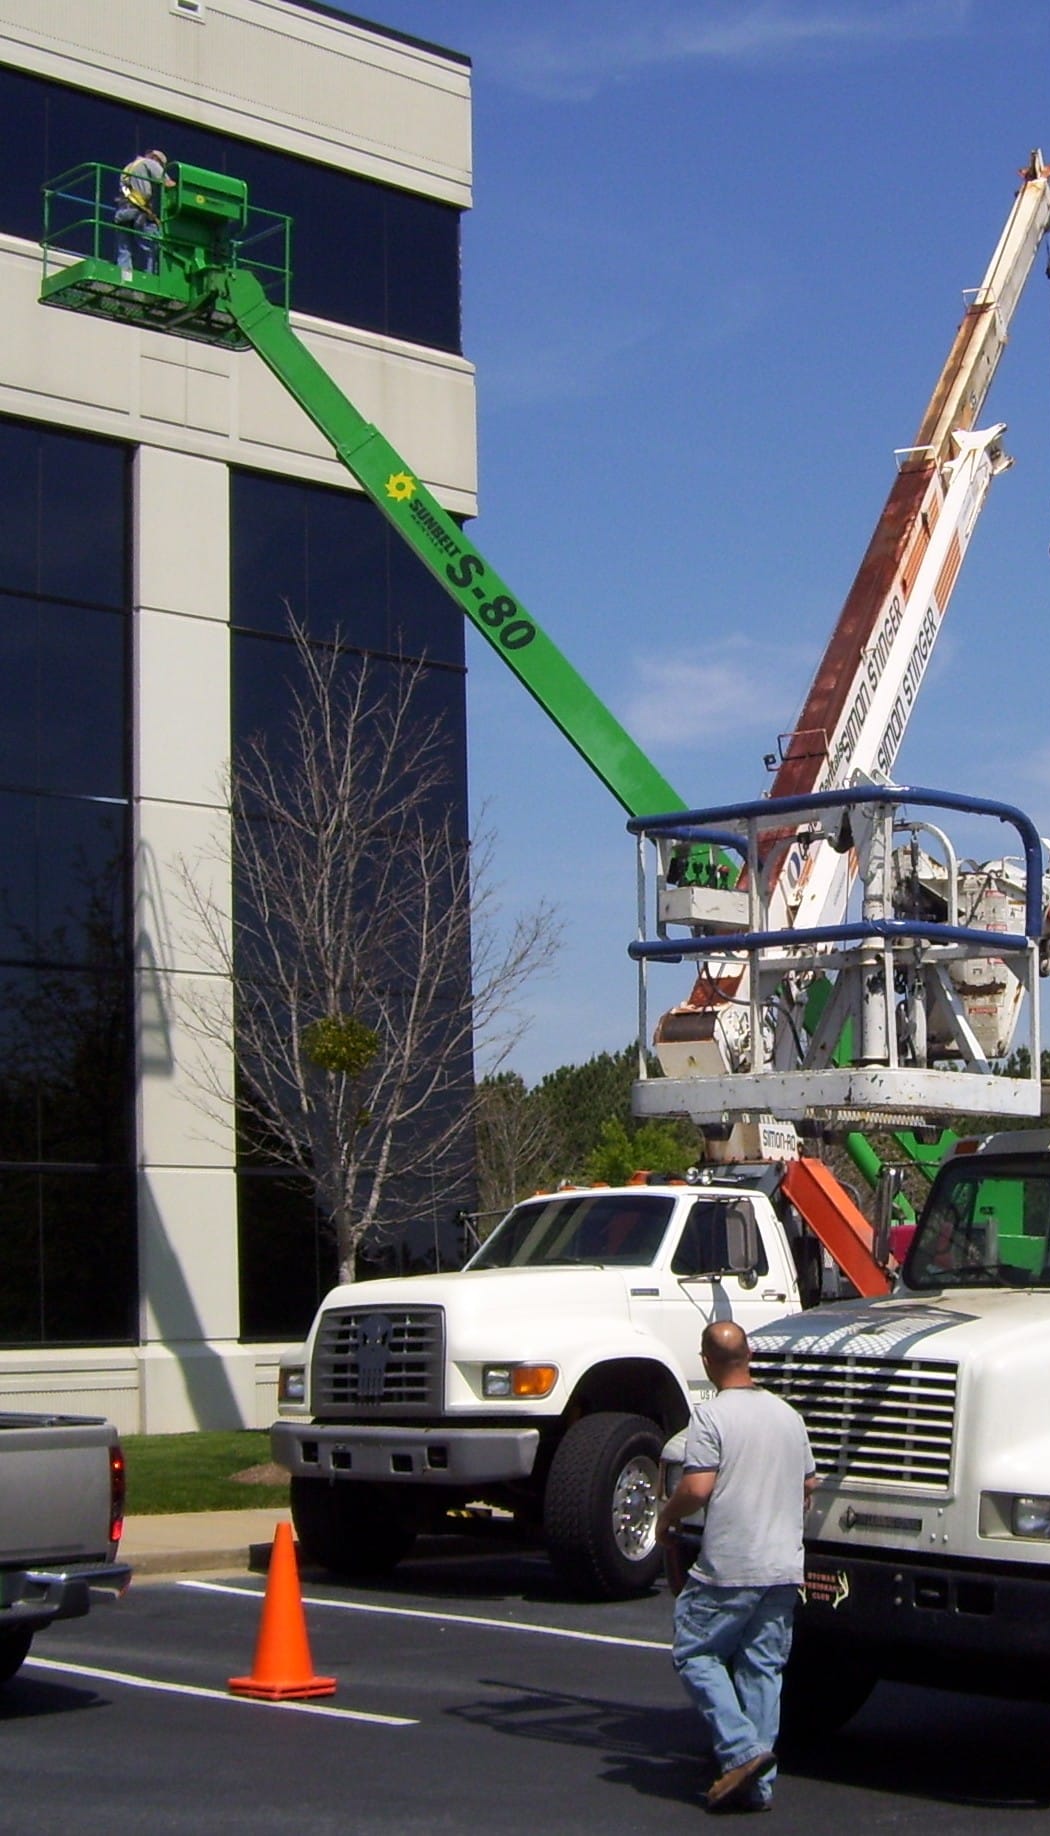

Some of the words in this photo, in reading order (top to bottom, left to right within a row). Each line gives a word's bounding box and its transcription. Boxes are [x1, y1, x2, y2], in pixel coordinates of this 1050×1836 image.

[409, 498, 462, 557] SUNBELT
[445, 554, 536, 650] S-80
[839, 682, 873, 763] SIMON
[866, 594, 904, 692] STINGER
[876, 695, 907, 776] SIMON
[902, 605, 937, 706] STINGER
